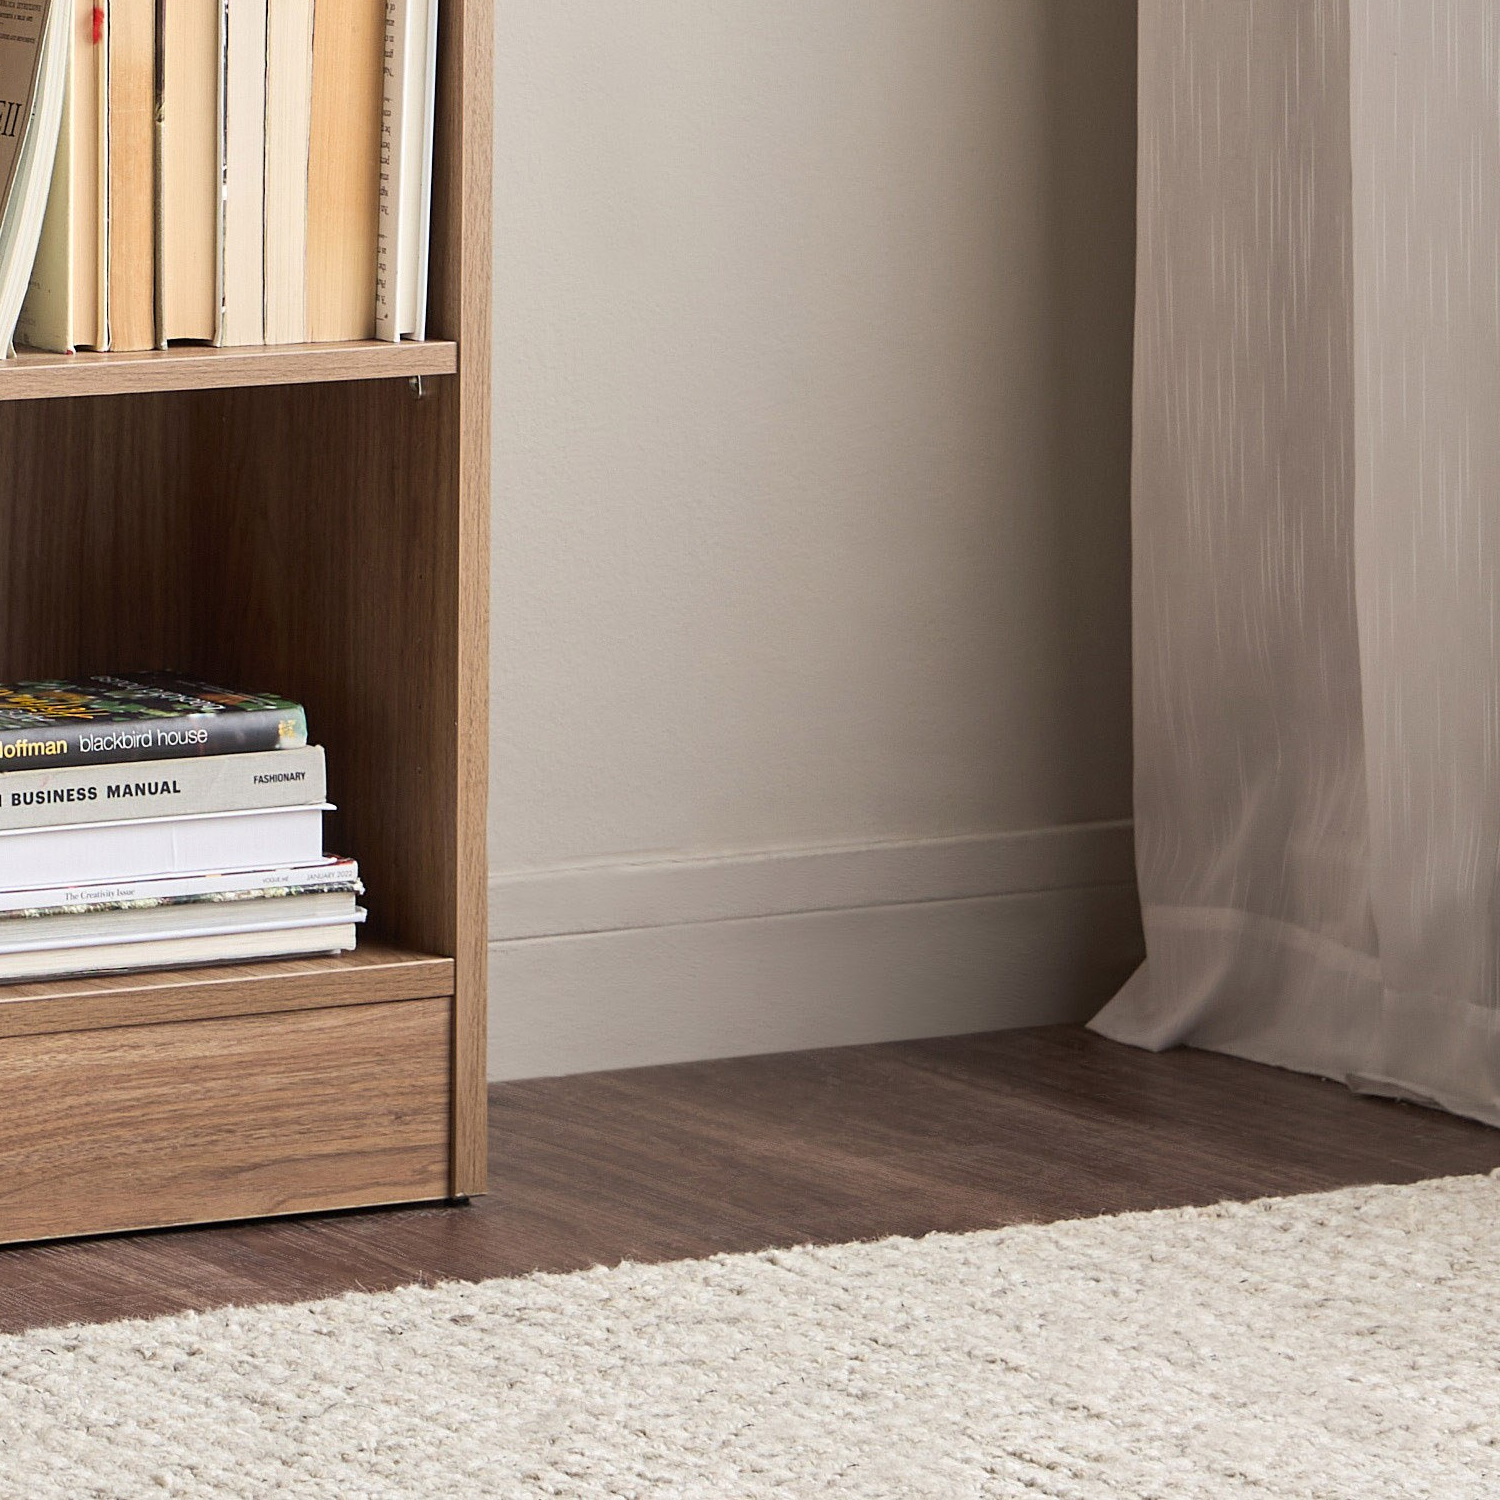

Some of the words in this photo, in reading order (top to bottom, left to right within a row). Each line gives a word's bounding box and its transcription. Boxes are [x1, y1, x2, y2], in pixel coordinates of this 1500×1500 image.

[79, 729, 152, 752] blackbird
[157, 728, 208, 746] house
[11, 786, 97, 806] BUSINESS
[107, 780, 181, 799] MANUAL
[253, 771, 306, 784] FASHIONARY
[306, 871, 335, 881] JANUARY
